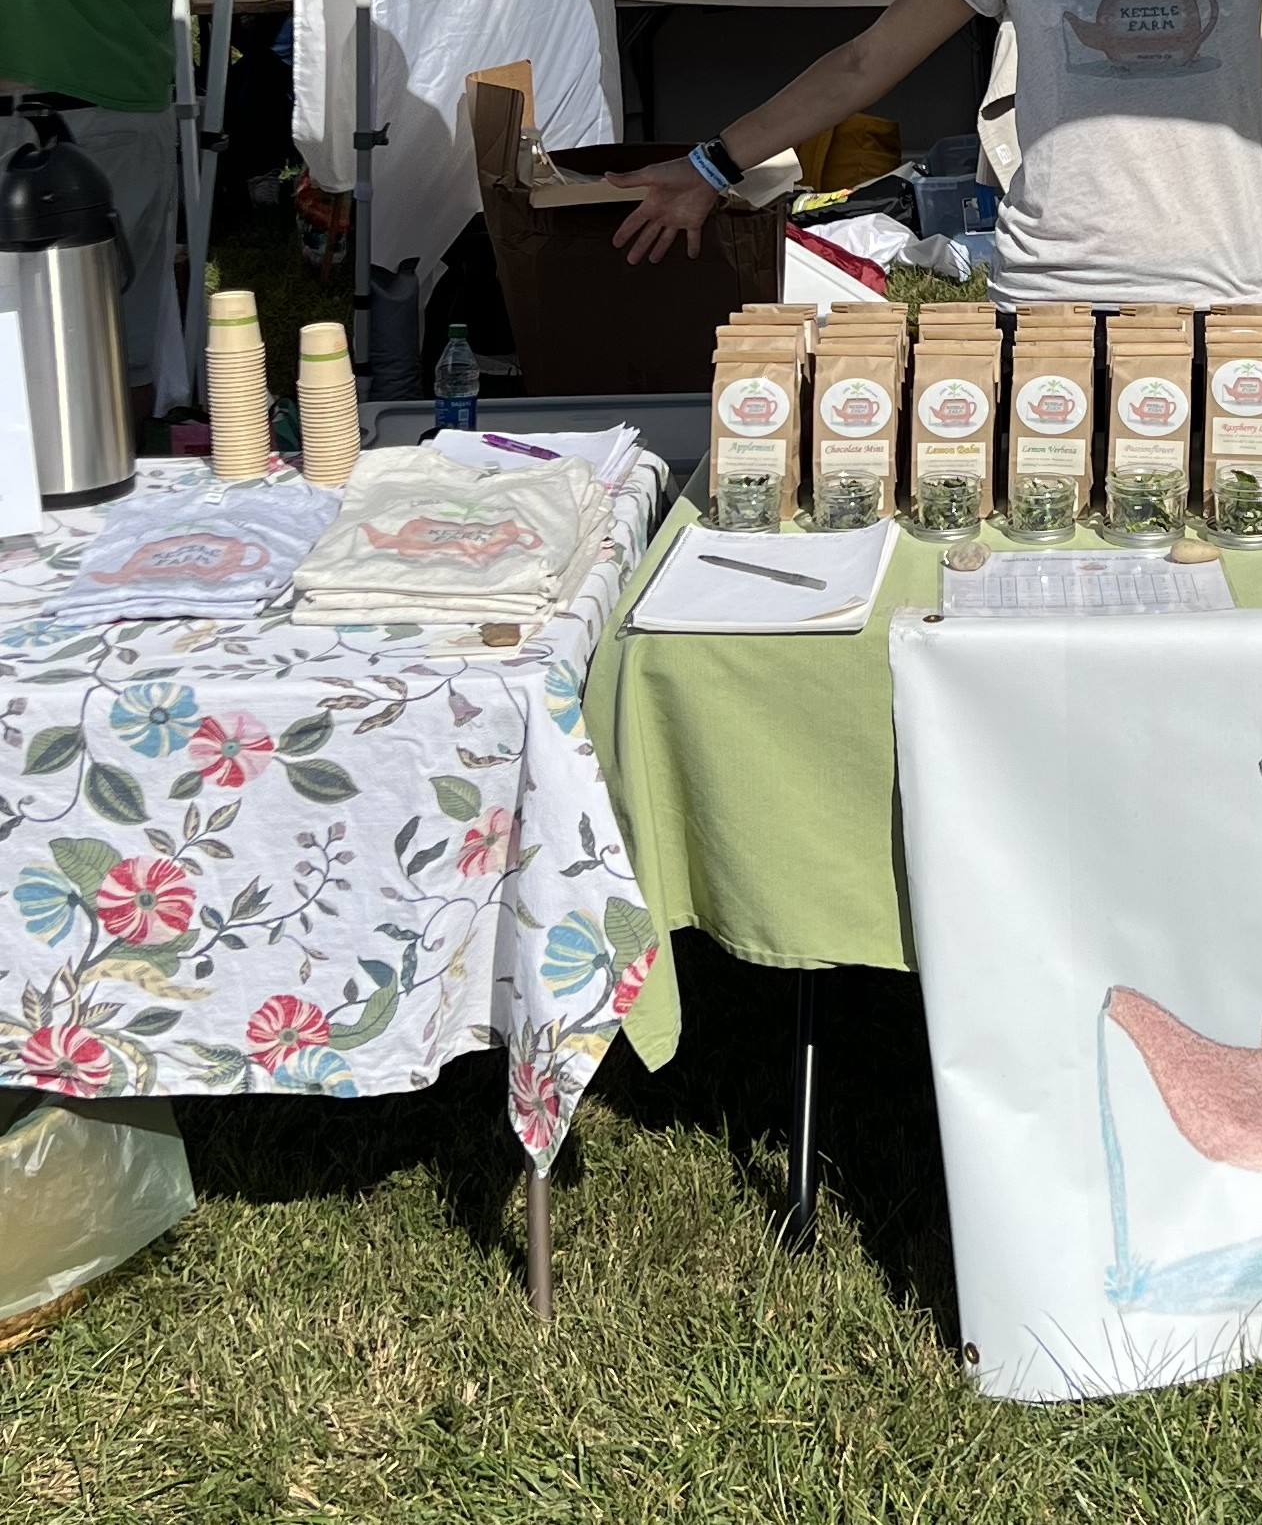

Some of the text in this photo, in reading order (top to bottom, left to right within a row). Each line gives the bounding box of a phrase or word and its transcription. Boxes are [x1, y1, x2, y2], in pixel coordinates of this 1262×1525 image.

[1119, 5, 1180, 19] KETTLE
[1126, 19, 1176, 32] FARM
[1221, 422, 1259, 435] Raspberry
[728, 441, 776, 454] Applemint
[825, 444, 885, 454] Chocolate Mint
[925, 444, 981, 455] Lemon Balm
[1021, 444, 1078, 455] Lemon Verbena
